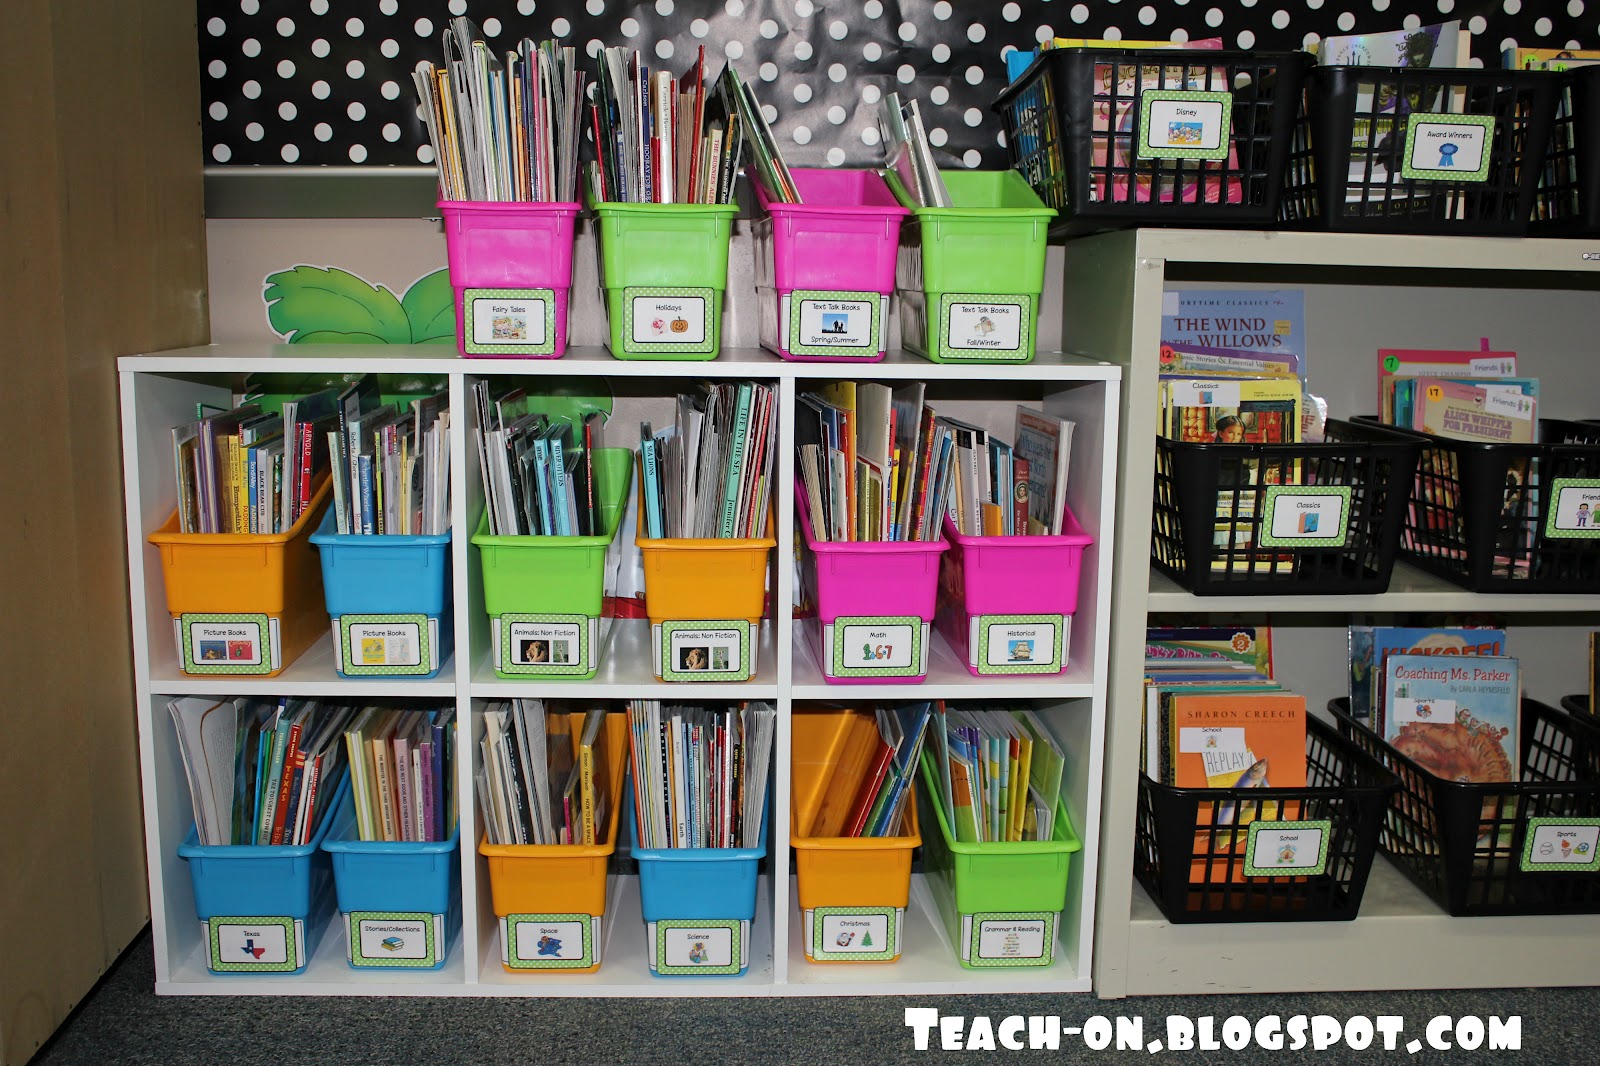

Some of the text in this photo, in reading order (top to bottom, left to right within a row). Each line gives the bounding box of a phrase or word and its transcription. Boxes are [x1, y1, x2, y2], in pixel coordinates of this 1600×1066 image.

[1176, 108, 1198, 117] Disney
[1427, 131, 1473, 140] Award Winners
[492, 306, 508, 314] Fairy
[655, 304, 682, 312] Holidays
[812, 303, 826, 311] Text
[828, 303, 840, 311] Talk
[962, 306, 976, 314] Text
[977, 306, 989, 314] Talk
[1174, 317, 1266, 332] THE WIND
[810, 336, 859, 345] Spring/Summer
[966, 339, 1001, 347] Fall/Winter
[1197, 334, 1282, 348] WILLOWS
[1162, 349, 1172, 359] 12
[1196, 354, 1217, 363] Stories
[1218, 356, 1227, 364] &
[1228, 357, 1254, 367] Essential
[1385, 357, 1396, 368] 7
[1474, 364, 1498, 372] Friends
[1429, 388, 1439, 397] 17
[1492, 396, 1517, 408] Friends
[1443, 409, 1471, 423] ALICE
[1472, 414, 1513, 431] WHIPPLE
[1442, 418, 1512, 440] FOR PRESIDENT
[304, 429, 312, 455] ARNOLD
[731, 407, 747, 476] LIFE IN THE SEA
[553, 445, 561, 462] RIVER
[1296, 501, 1321, 509] Classics
[722, 498, 735, 529] Jennifer
[362, 629, 406, 637] Picture Books
[514, 629, 576, 637] Animals: Non Fiction
[674, 632, 737, 640] Animals: Non Fiction
[1237, 639, 1245, 650] 2
[1395, 665, 1511, 684] Coaching Ms. Parker
[1450, 685, 1458, 693] By
[1459, 685, 1477, 694] CARLA
[1187, 710, 1296, 719] SHARON CREECH
[1206, 751, 1246, 774] REPLAY
[279, 765, 291, 802] TEXAS
[1556, 831, 1577, 839] Sports
[364, 925, 421, 933] Stories/Collections
[539, 928, 559, 936] Space
